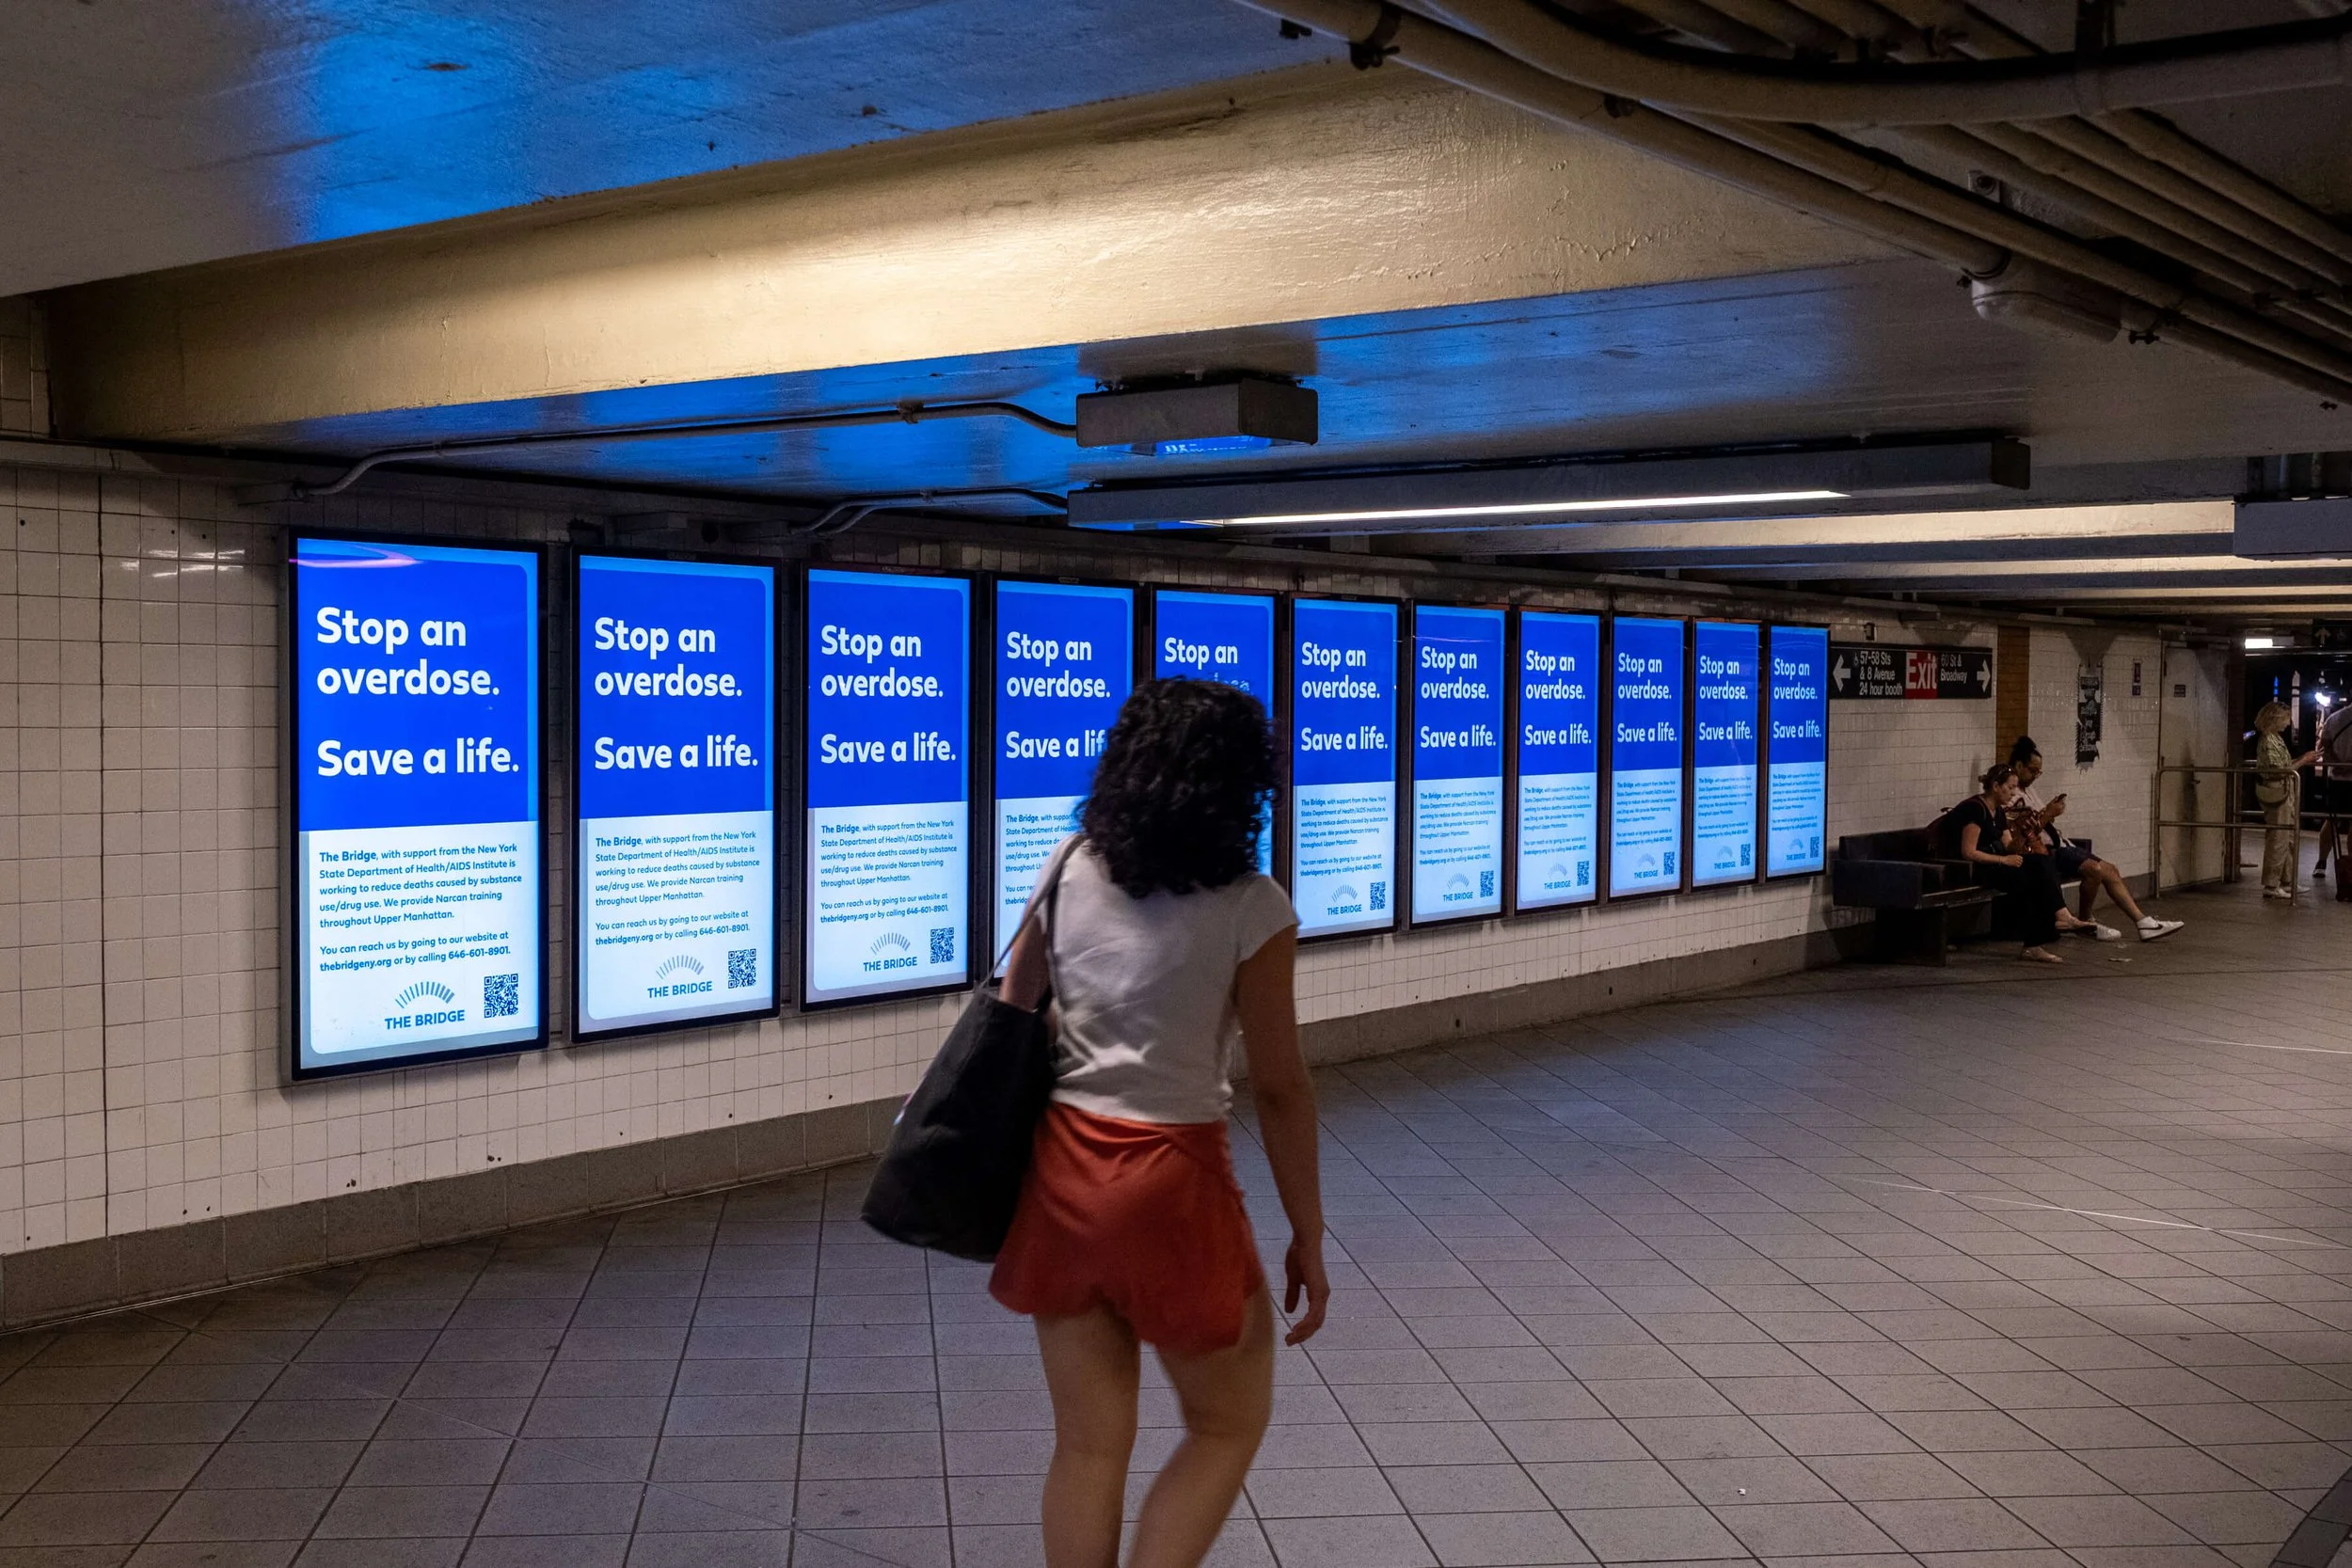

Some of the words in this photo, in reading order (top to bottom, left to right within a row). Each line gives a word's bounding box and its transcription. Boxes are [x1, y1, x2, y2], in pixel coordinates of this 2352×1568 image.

[317, 607, 408, 654] Stop
[420, 620, 466, 645] an
[595, 617, 669, 659] Stop
[677, 628, 715, 652] an
[821, 625, 882, 663] Stop
[890, 635, 921, 657] an
[1007, 631, 1058, 667] Stop
[1065, 641, 1091, 660] an
[1165, 637, 1210, 670] Stop
[1215, 644, 1238, 664] an
[1301, 641, 1341, 672] Stop
[1345, 649, 1365, 666] an
[1421, 645, 1455, 674] Stop
[1459, 653, 1476, 669] an
[1525, 649, 1555, 676] Stop
[1559, 656, 1574, 671] an
[1618, 652, 1645, 677] Stop
[1647, 658, 1661, 673] an
[1699, 655, 1724, 679] Stop
[1726, 660, 1739, 674] an
[1860, 651, 1880, 665] 57-58
[1881, 652, 1891, 666] Sts
[1950, 655, 1957, 666] St
[1957, 655, 1963, 667] &
[317, 658, 499, 694] overdose.
[595, 663, 741, 696] overdose.
[1773, 657, 1796, 680] Stop
[1798, 663, 1809, 675] an
[1860, 669, 1865, 680] &
[1867, 669, 1872, 680] 8
[1874, 668, 1896, 680] Avenue
[1906, 652, 1937, 689] Exit
[1941, 669, 1967, 684] Broadway
[820, 667, 943, 697] overdose.
[1006, 670, 1110, 697] overdose.
[1301, 674, 1379, 698] overdose.
[1421, 676, 1488, 698] overdose.
[1525, 678, 1585, 699] overdose.
[1617, 679, 1671, 699] overdose.
[1699, 680, 1747, 699] overdose.
[1773, 681, 1817, 699] overdose.
[1859, 683, 1868, 696] 24
[1869, 683, 1884, 695] hour
[1884, 683, 1902, 696] booth
[1301, 727, 1342, 751] Save
[1345, 733, 1356, 750] a
[1359, 725, 1388, 749] life.
[1420, 725, 1455, 748] Save
[1459, 731, 1468, 747] a
[1471, 724, 1496, 746] life.
[1524, 724, 1556, 745] Save
[1558, 729, 1566, 744] a
[1569, 722, 1591, 744] life.
[1616, 722, 1645, 742] Save
[1647, 727, 1655, 741] a
[1657, 721, 1677, 741] life.
[1698, 721, 1724, 740] Save
[1725, 726, 1732, 739] a
[1735, 721, 1752, 739] life.
[1772, 721, 1796, 738] Save
[1797, 724, 1804, 737] a
[1805, 720, 1821, 737] life.
[595, 736, 672, 769] Save
[679, 744, 698, 768] a
[707, 734, 757, 767] life.
[820, 734, 884, 763] Save
[891, 740, 906, 762] a
[914, 731, 956, 761] life.
[1006, 731, 1059, 758] Save
[1065, 737, 1078, 757] a
[317, 739, 413, 776] Save
[422, 749, 445, 773] a
[456, 736, 518, 772] life.
[595, 837, 612, 847] The
[613, 835, 643, 847] Bridge,
[644, 835, 661, 844] with
[662, 834, 691, 845] support
[319, 851, 339, 862] The
[342, 849, 378, 863] Bridge,
[380, 849, 401, 859] with
[402, 847, 437, 859] support
[438, 847, 459, 855] from
[461, 846, 475, 854] the
[477, 845, 497, 853] New
[499, 843, 516, 852] York
[319, 869, 344, 879] State
[346, 865, 403, 879] Department
[405, 863, 414, 873] of
[416, 861, 470, 873] Health/AIDS
[472, 860, 507, 869] Institute
[509, 859, 516, 867] is
[1643, 869, 1658, 878] BRIDGE
[319, 884, 357, 895] working
[371, 881, 401, 892] reduce
[403, 879, 434, 889] deaths
[436, 877, 466, 887] caused
[468, 877, 478, 887] by
[480, 875, 521, 884] substance
[820, 878, 855, 888] throughout
[856, 877, 875, 885] Upper
[876, 874, 911, 882] Manhattan.
[1553, 879, 1570, 889] BRIDGE
[319, 900, 361, 912] use/drug
[383, 897, 398, 907] We
[400, 895, 434, 908] provide
[436, 895, 467, 903] Narcan
[469, 891, 501, 901] training
[1442, 894, 1453, 902] THE
[1454, 891, 1472, 900] BRIDGE
[319, 916, 372, 928] throughout
[373, 914, 402, 925] Upper
[403, 911, 454, 921] Manhattan.
[1327, 907, 1339, 915] THE
[1340, 904, 1361, 914] BRIDGE
[319, 945, 337, 955] You
[358, 941, 384, 952] reach
[398, 939, 409, 950] by
[410, 938, 436, 949] going
[465, 932, 498, 942] website
[499, 931, 509, 940] at
[595, 934, 653, 945] thebridgeny.org
[663, 930, 673, 940] by
[674, 928, 697, 938] calling
[699, 923, 750, 935] 646-601-8901.
[319, 958, 391, 972] thebridgeny.org
[405, 955, 416, 965] by
[418, 952, 446, 962] calling
[448, 945, 510, 959] 646-601-8901.
[863, 960, 881, 972] THE
[883, 956, 917, 970] BRIDGE
[646, 986, 669, 998] THE
[672, 980, 712, 995] BRIDGE
[384, 1015, 411, 1030] THE
[415, 1009, 465, 1026] BRIDGE
